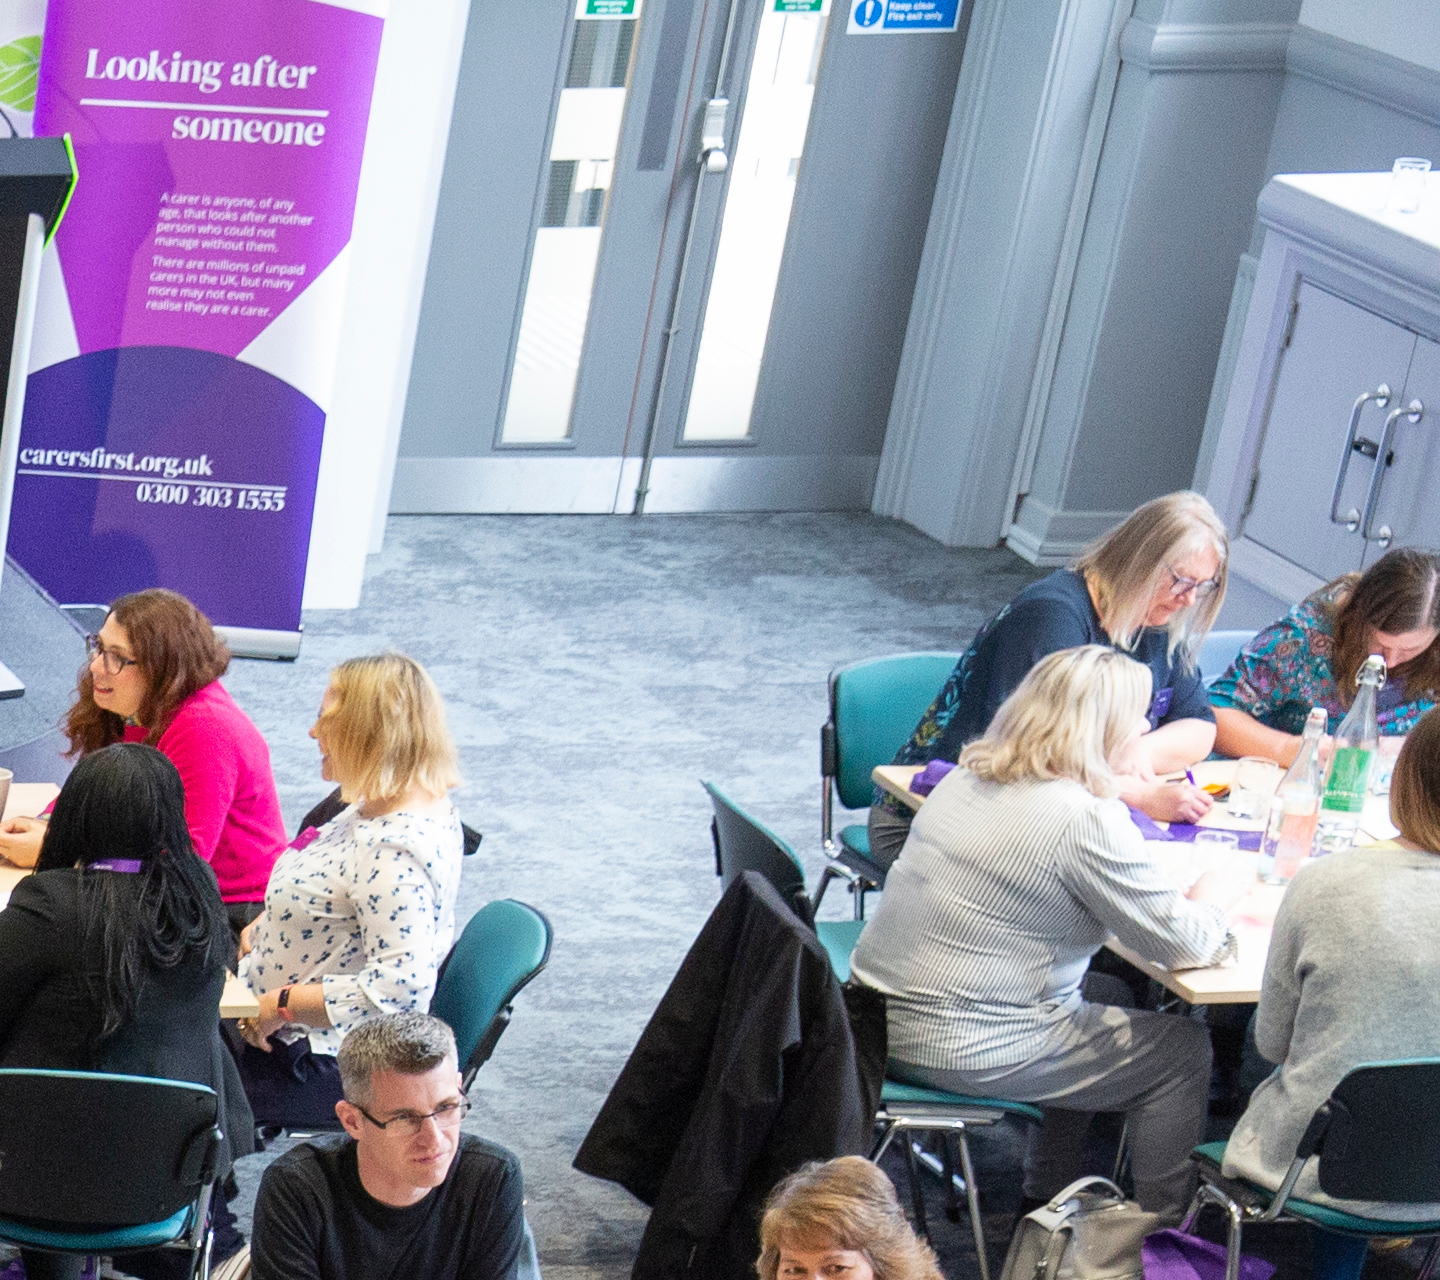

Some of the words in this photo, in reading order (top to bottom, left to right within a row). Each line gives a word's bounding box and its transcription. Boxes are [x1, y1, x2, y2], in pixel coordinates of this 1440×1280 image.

[85, 48, 225, 94] Looking
[230, 54, 317, 89] after
[172, 115, 326, 147] someone
[160, 193, 168, 203] A
[171, 195, 200, 204] carer
[202, 195, 211, 205] is
[259, 198, 273, 209] of
[273, 201, 295, 212] any
[184, 209, 206, 219] that
[208, 210, 238, 221] looks
[240, 211, 267, 223] after
[269, 214, 315, 226] another
[156, 222, 196, 234] person
[198, 224, 222, 235] who
[224, 226, 255, 237] could
[257, 227, 276, 238] not
[155, 236, 200, 250] manage
[201, 238, 244, 251] without
[152, 255, 184, 269] There
[186, 260, 205, 270] are
[206, 260, 249, 272] millions
[252, 262, 265, 272] of
[266, 264, 306, 276] unpaid
[150, 272, 184, 283] carers
[186, 274, 198, 283] in
[199, 274, 218, 285] the
[241, 276, 261, 288] but
[262, 279, 295, 292] many
[147, 286, 179, 297] more
[180, 288, 205, 301] may
[206, 289, 226, 300] not
[227, 292, 254, 301] even
[146, 300, 182, 312] realise
[184, 301, 209, 315] they
[210, 305, 229, 314] are
[231, 306, 238, 315] a
[19, 447, 213, 478] carersfirst.org.uk
[136, 482, 189, 505] 0300
[193, 487, 232, 508] 303
[236, 489, 286, 512] 1555
